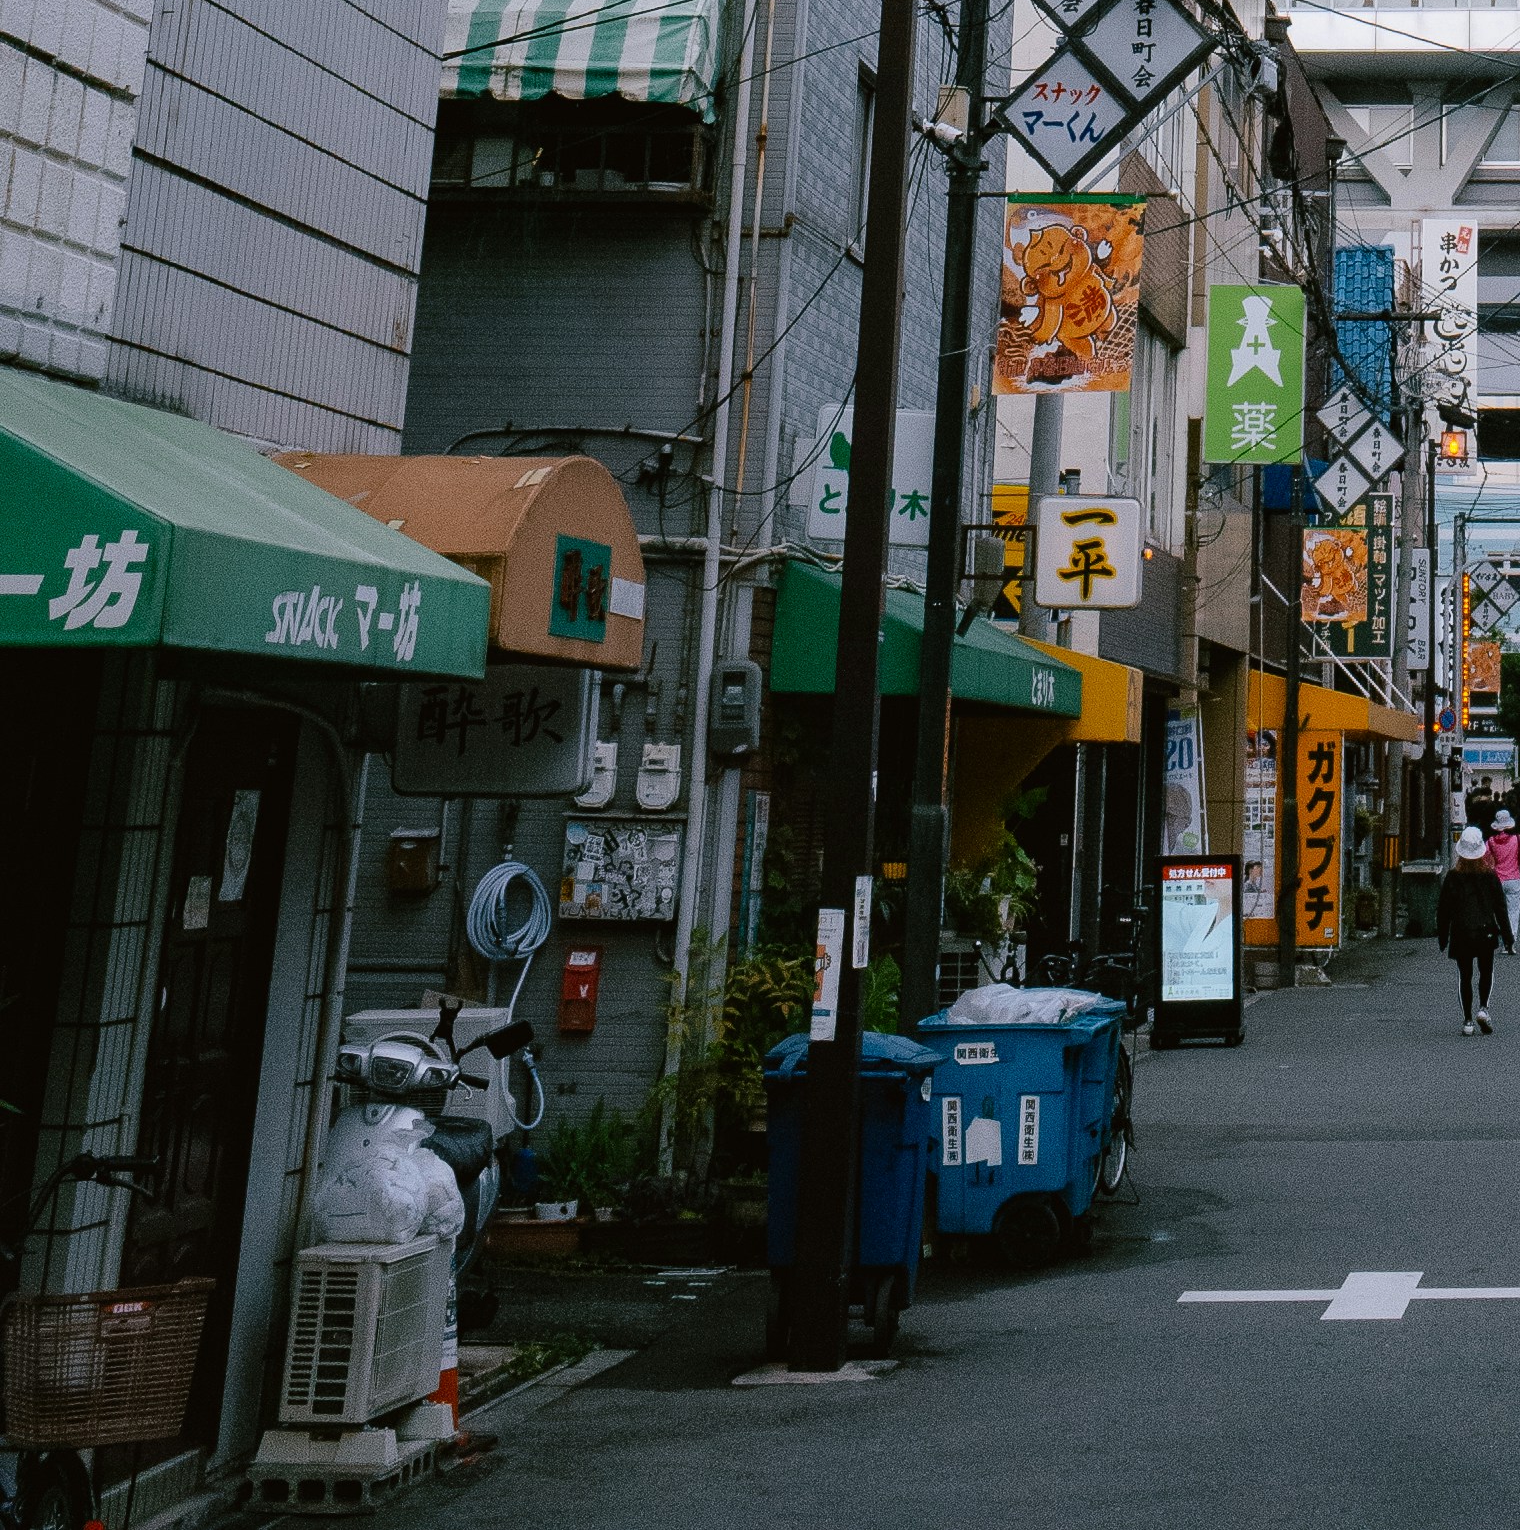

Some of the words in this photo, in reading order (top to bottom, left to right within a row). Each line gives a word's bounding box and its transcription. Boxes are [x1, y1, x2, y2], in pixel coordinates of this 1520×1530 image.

[1031, 81, 1102, 104] スナック
[1021, 109, 1107, 145] マーくん
[1231, 401, 1278, 451] 薬
[1057, 507, 1118, 601] 一平
[1418, 558, 1428, 606] SUNTORY
[264, 584, 344, 651] SNACK
[354, 582, 421, 662] マー坊
[1031, 666, 1056, 709] とまり木
[415, 684, 565, 758] 酔歌
[1304, 740, 1336, 931] ガクブチ
